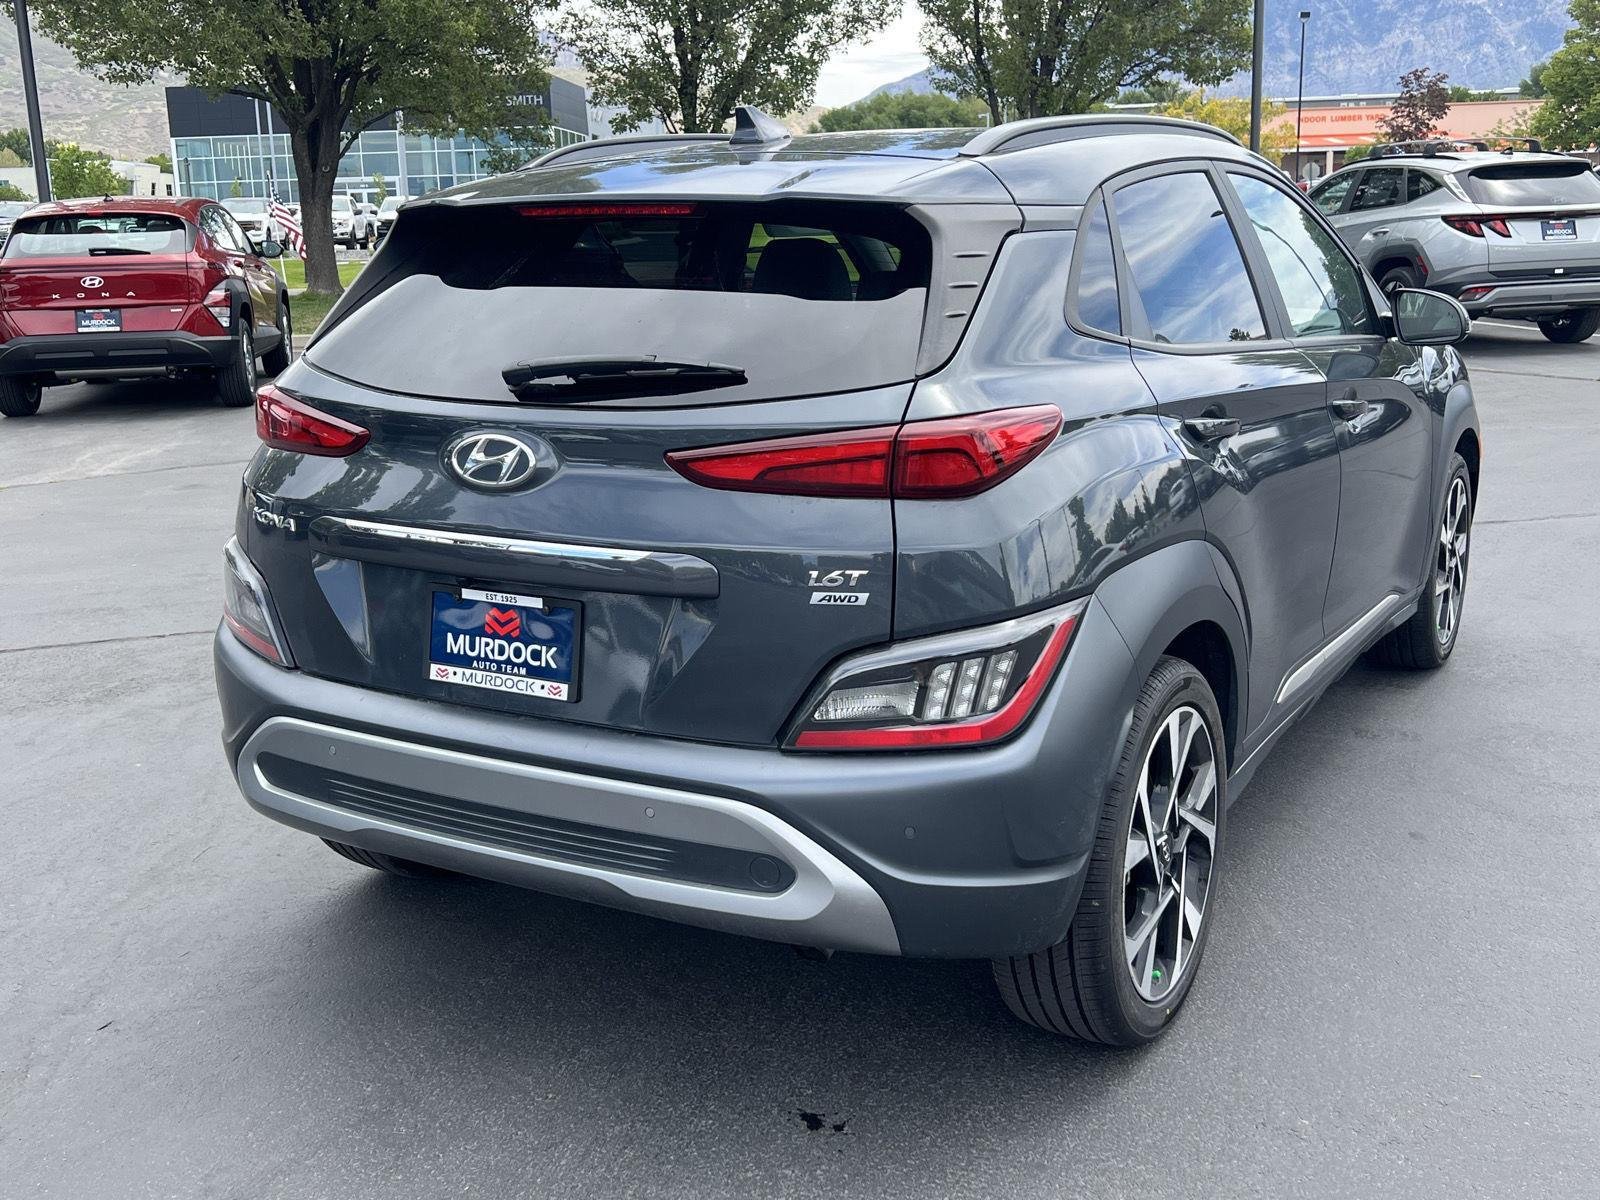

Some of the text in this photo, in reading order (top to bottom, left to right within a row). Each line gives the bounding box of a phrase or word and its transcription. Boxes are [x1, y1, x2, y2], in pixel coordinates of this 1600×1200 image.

[505, 94, 543, 107] SMITH
[1330, 113, 1362, 122] LUMBER
[52, 291, 136, 299] KONA
[500, 594, 518, 604] 1925
[817, 594, 860, 604] AWD
[446, 632, 558, 669] MURDOCK
[472, 660, 527, 675] AUTO TEAM
[461, 670, 536, 693] MURDOCK
